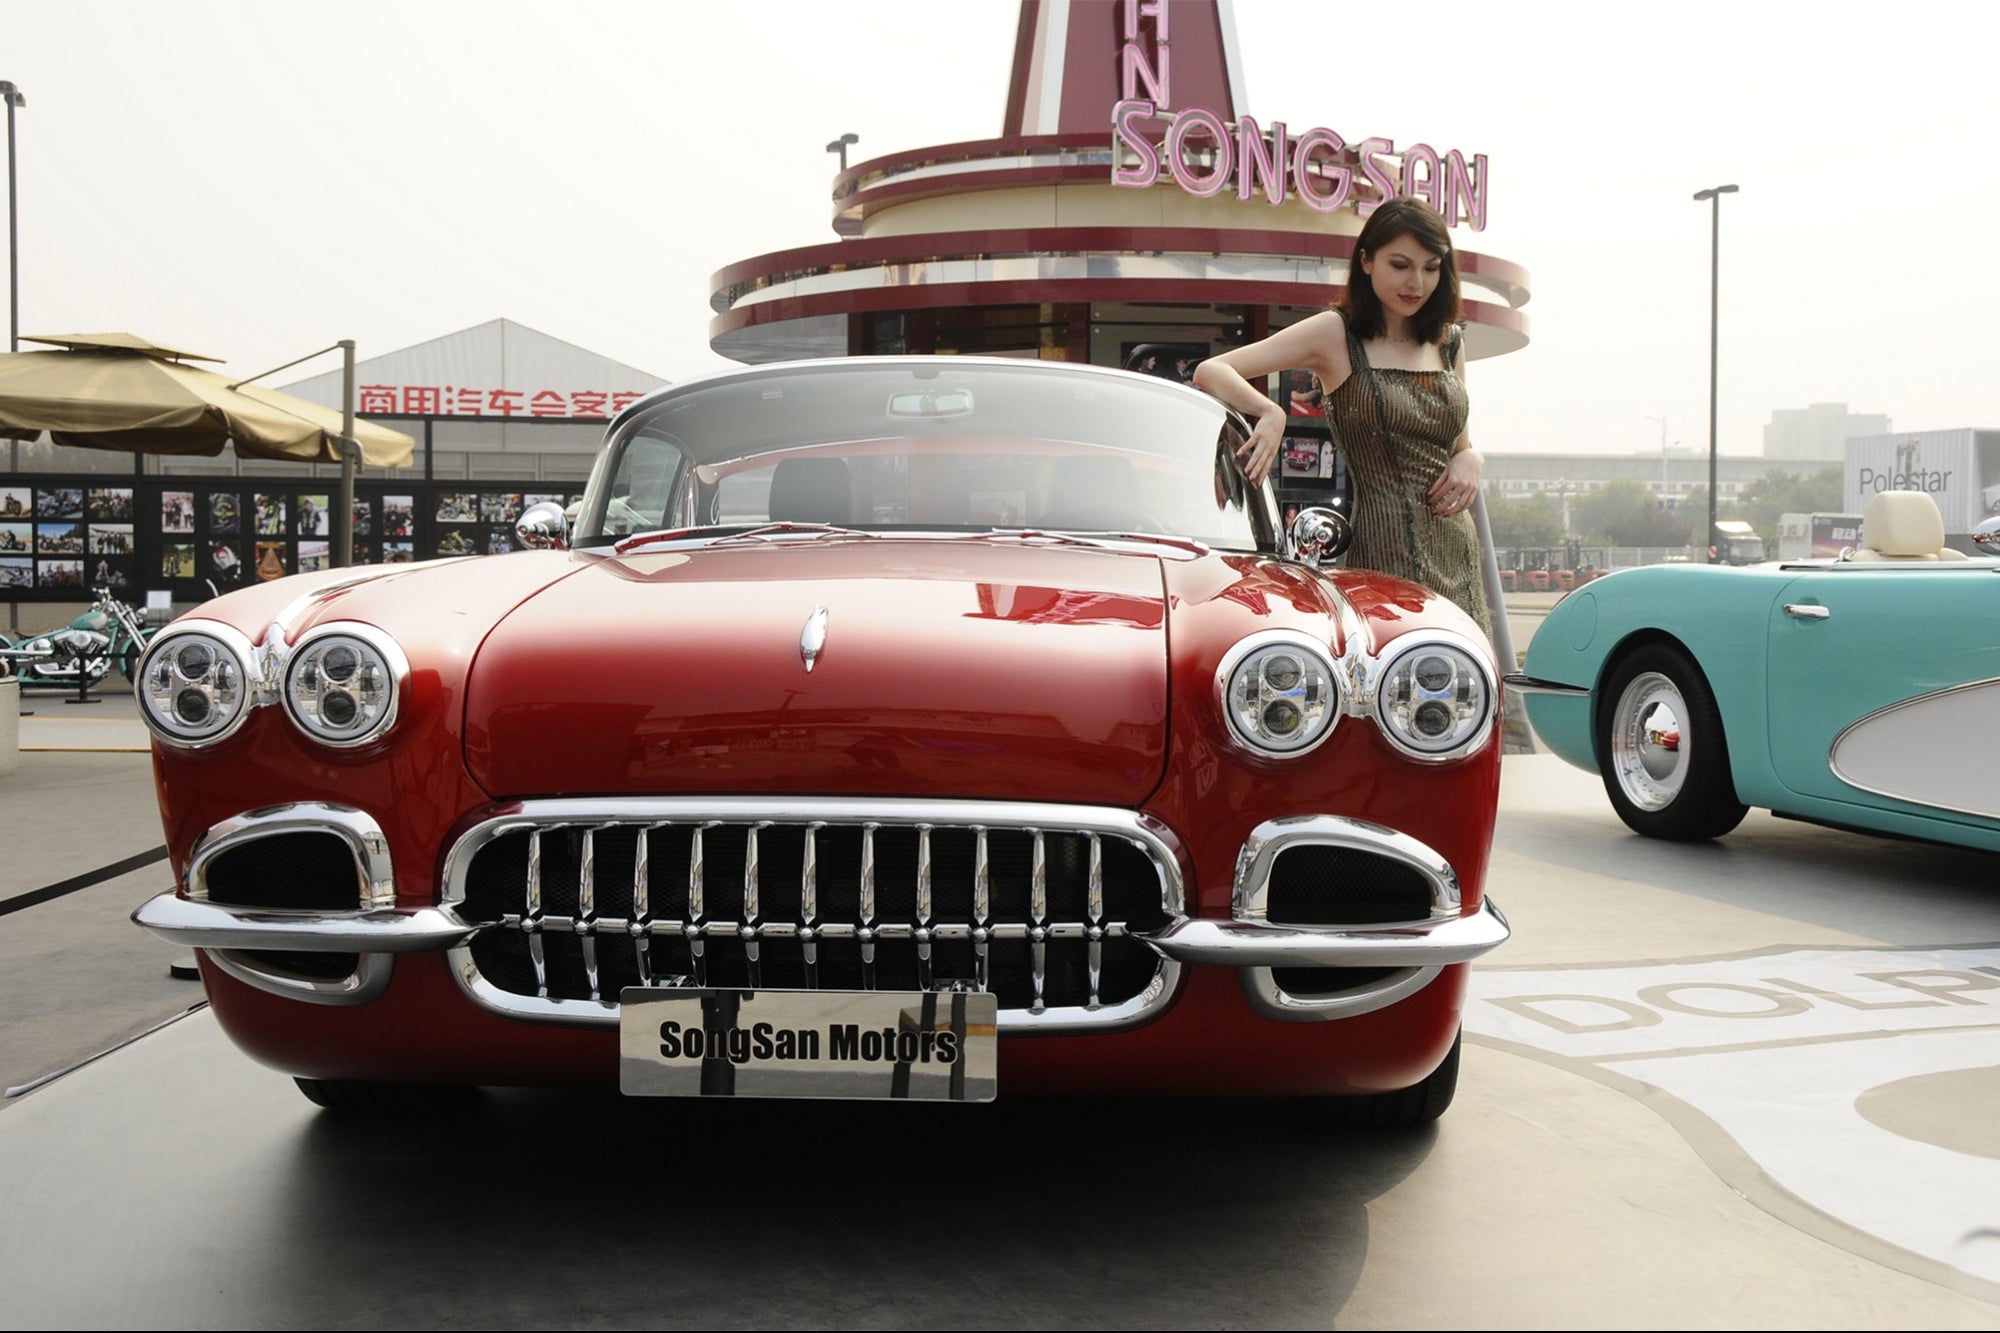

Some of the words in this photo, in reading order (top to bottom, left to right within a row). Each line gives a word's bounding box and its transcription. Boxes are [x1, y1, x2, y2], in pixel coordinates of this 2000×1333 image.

[1111, 99, 1488, 232] SONGSAN
[1860, 466, 1953, 495] Polestar
[1481, 966, 2000, 1035] DOLP
[660, 1020, 819, 1064] SongSan
[828, 1024, 958, 1064] Motors
